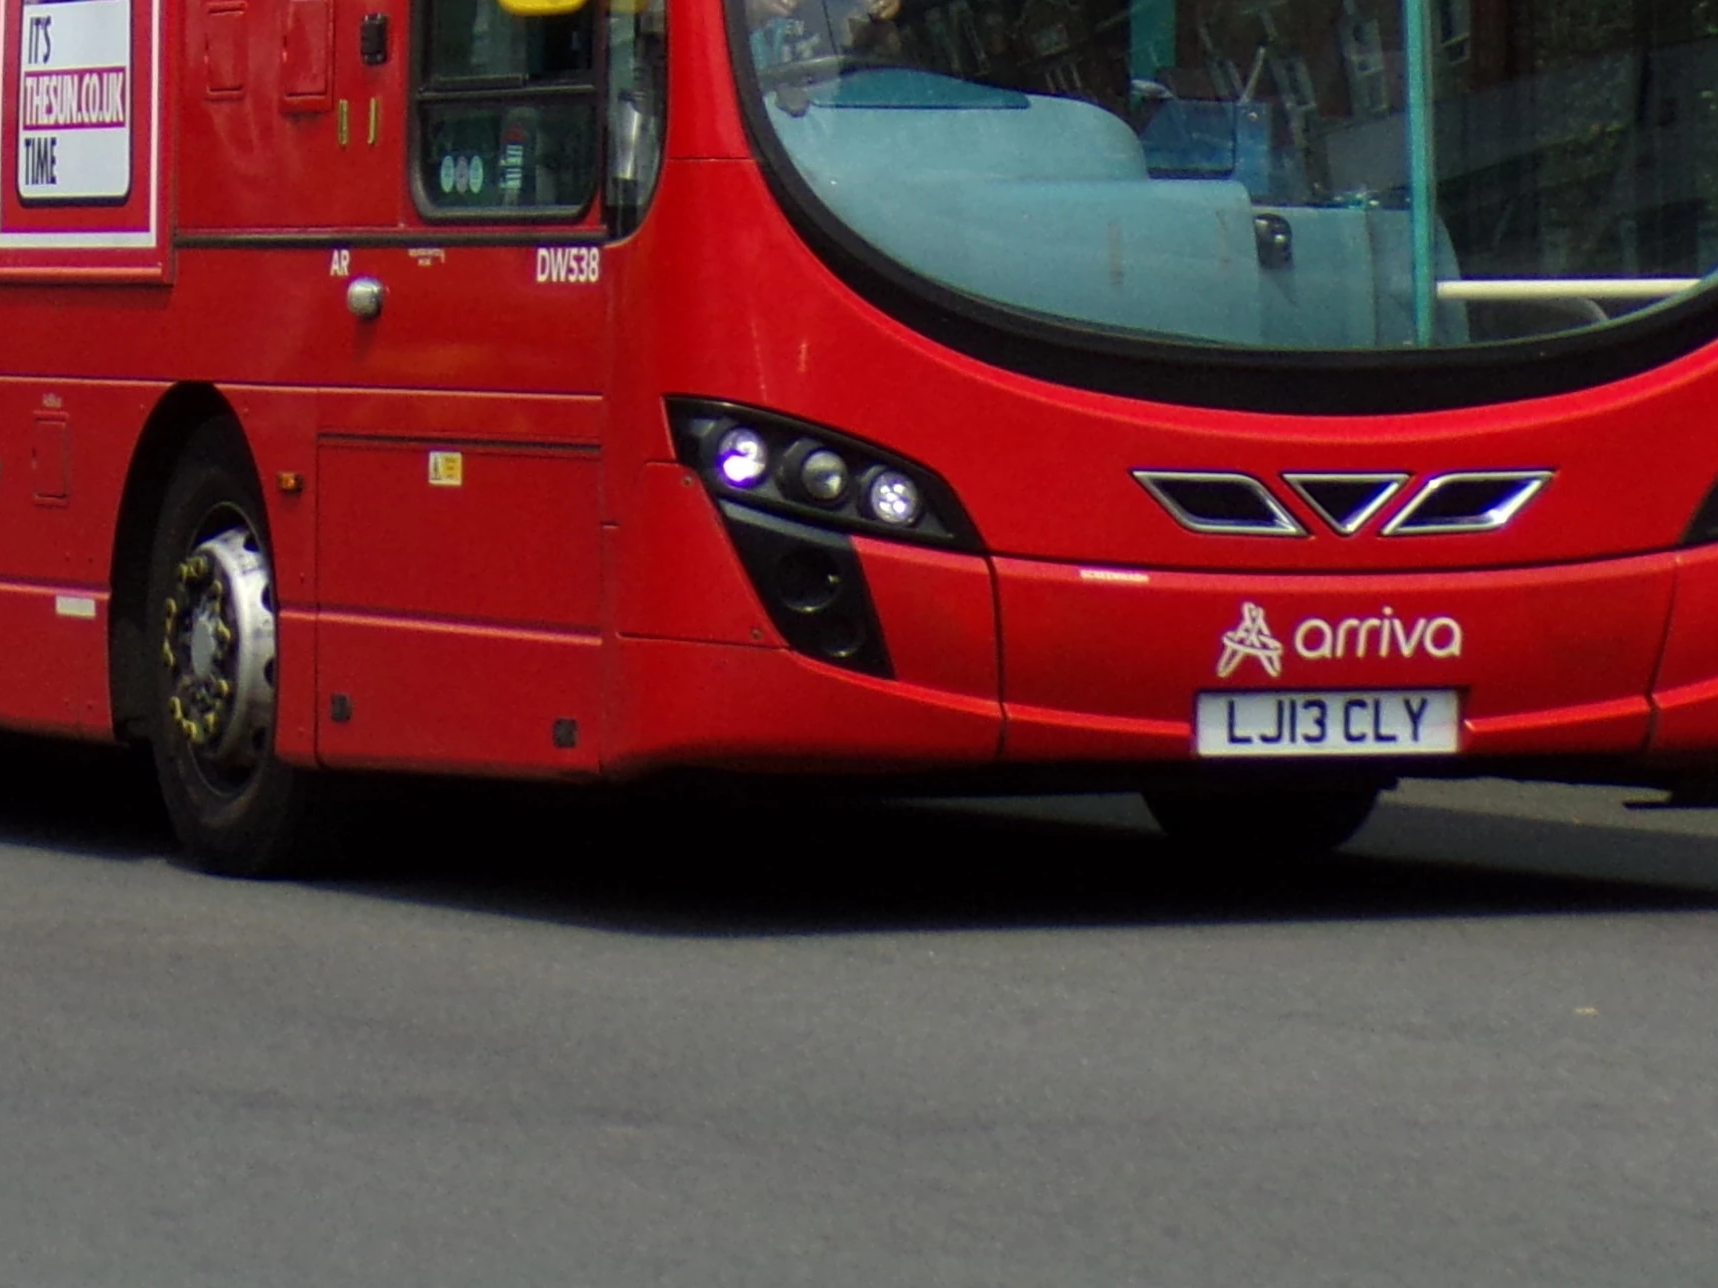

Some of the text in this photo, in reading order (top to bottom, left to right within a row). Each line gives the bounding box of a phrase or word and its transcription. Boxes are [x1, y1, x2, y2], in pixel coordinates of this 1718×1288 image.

[25, 137, 57, 186] TIME
[330, 249, 350, 276] AR
[536, 247, 600, 283] DW538
[1295, 606, 1463, 659] arriva
[1226, 697, 1429, 745] LJ13 CLY
